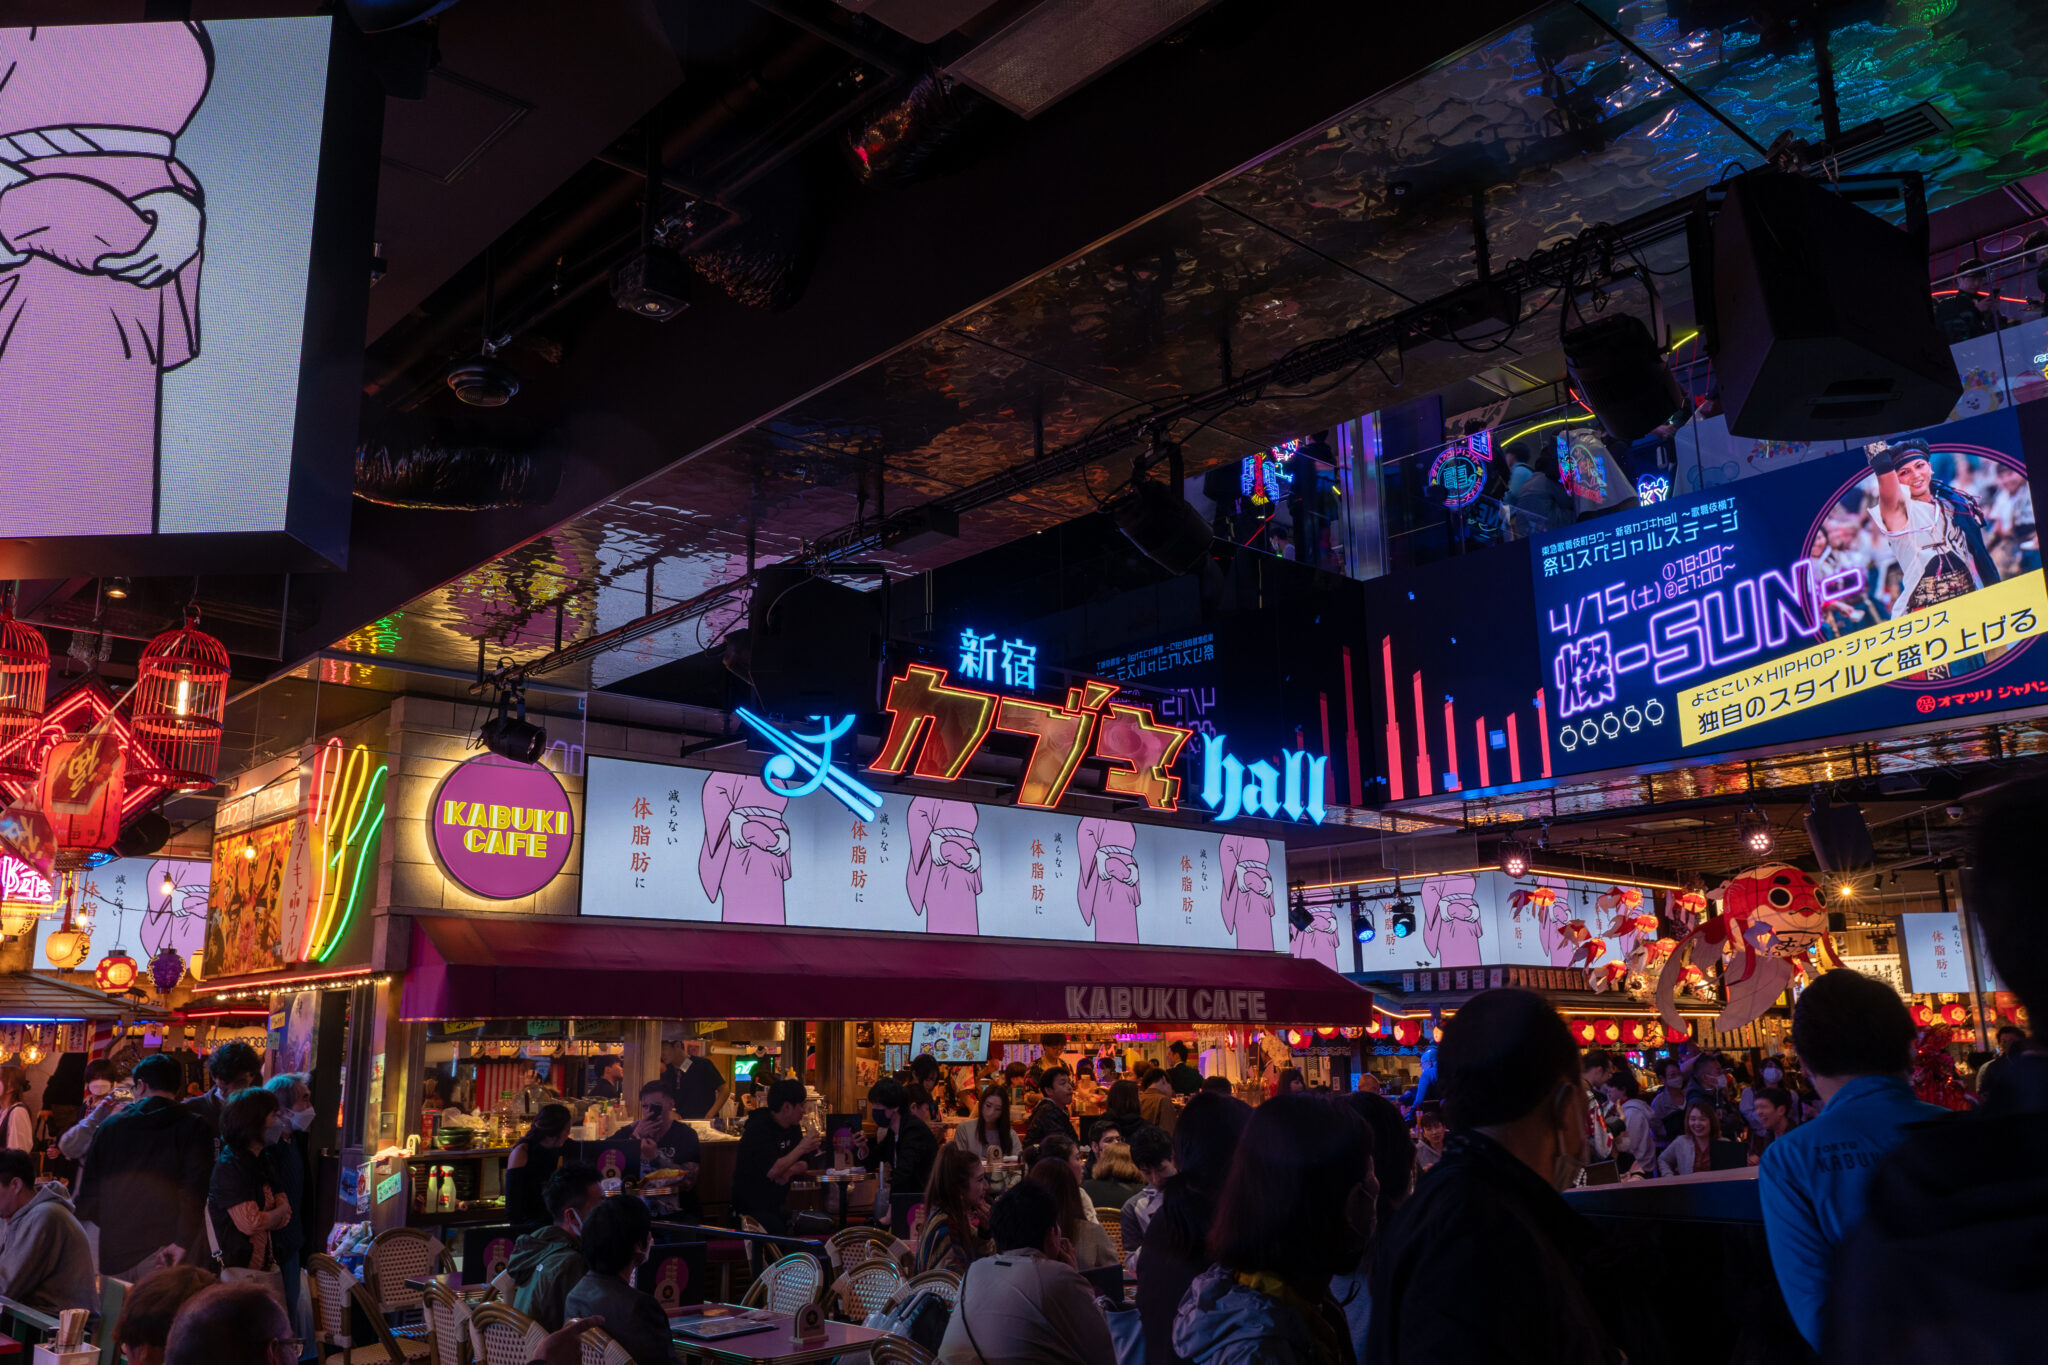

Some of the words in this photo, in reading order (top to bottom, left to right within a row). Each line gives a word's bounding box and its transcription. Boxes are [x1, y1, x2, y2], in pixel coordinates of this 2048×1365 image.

[1544, 510, 1739, 577] 祭りスペシャルステージ
[959, 628, 1037, 689] 新宿
[1697, 607, 2038, 736] 独自のスタイルで盛り上げる
[1200, 731, 1329, 826] hall
[443, 799, 568, 836] KABUKI
[463, 829, 548, 858] CAFE
[630, 796, 654, 889] 体脂肪に
[666, 789, 681, 846] 減らない
[879, 813, 890, 864] 減らない
[850, 820, 868, 903] 体脂肪に
[1030, 839, 1046, 915] 体脂肪に
[1053, 832, 1063, 879] 減らない
[1199, 849, 1209, 892] 減らない
[1180, 855, 1194, 925] 体脂肪に
[1931, 930, 1948, 978] 体脂肪に
[1065, 985, 1189, 1020] KABUKI
[1193, 989, 1268, 1021] CAFE
